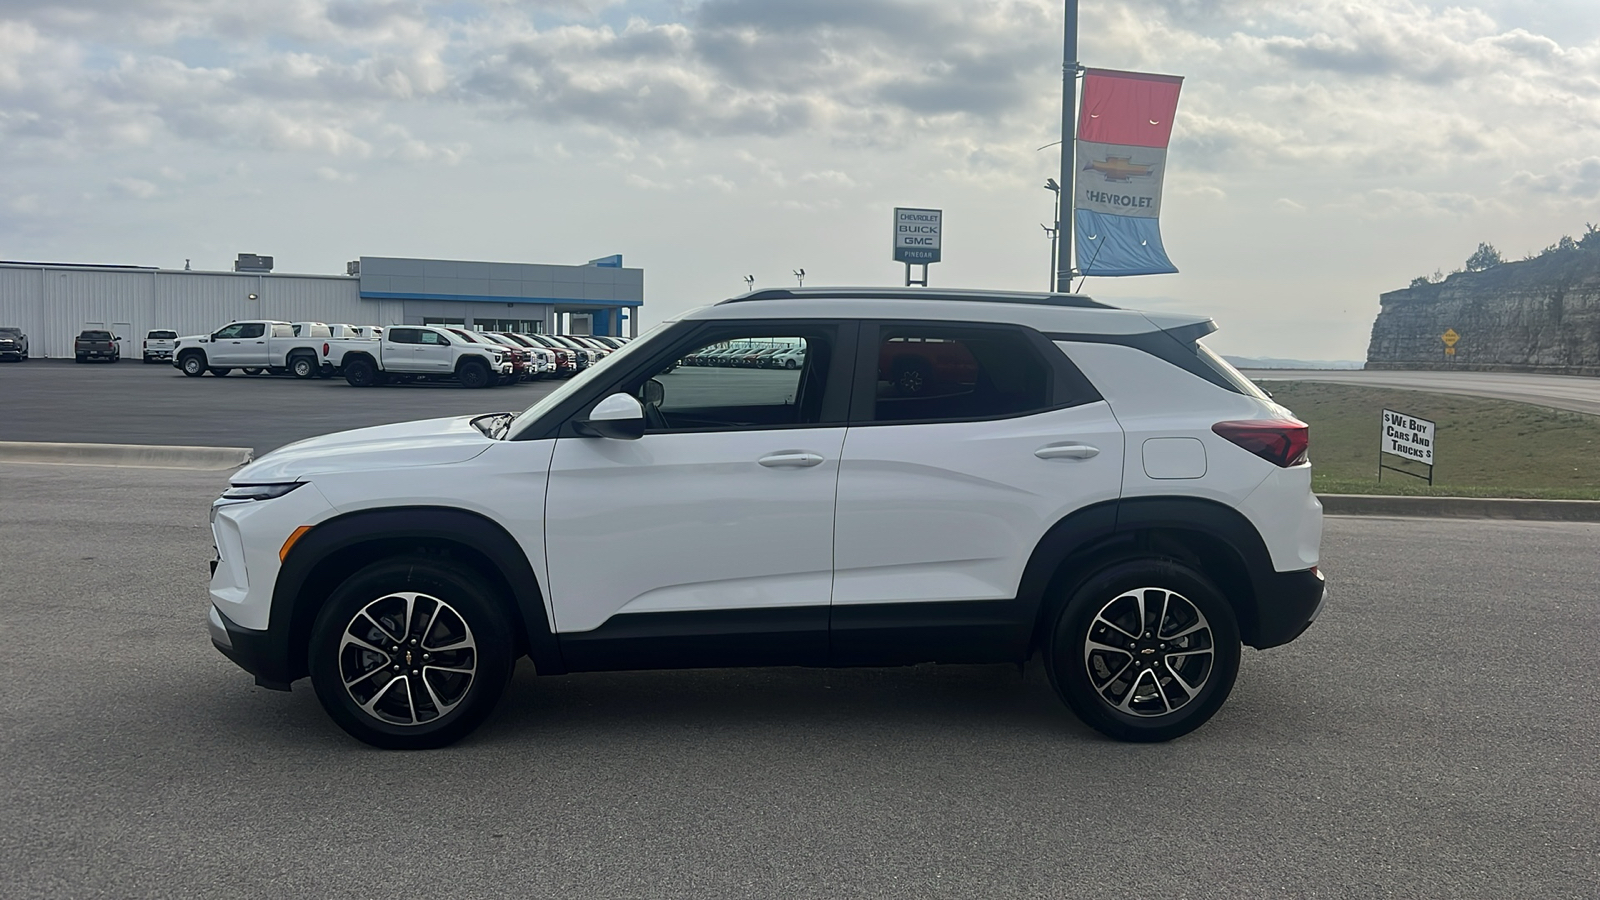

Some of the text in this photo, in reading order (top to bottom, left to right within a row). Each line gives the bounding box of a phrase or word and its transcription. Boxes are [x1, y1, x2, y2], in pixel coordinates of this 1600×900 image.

[900, 213, 938, 221] CHEVROLET
[899, 225, 938, 234] BUICK
[904, 237, 933, 246] GMC
